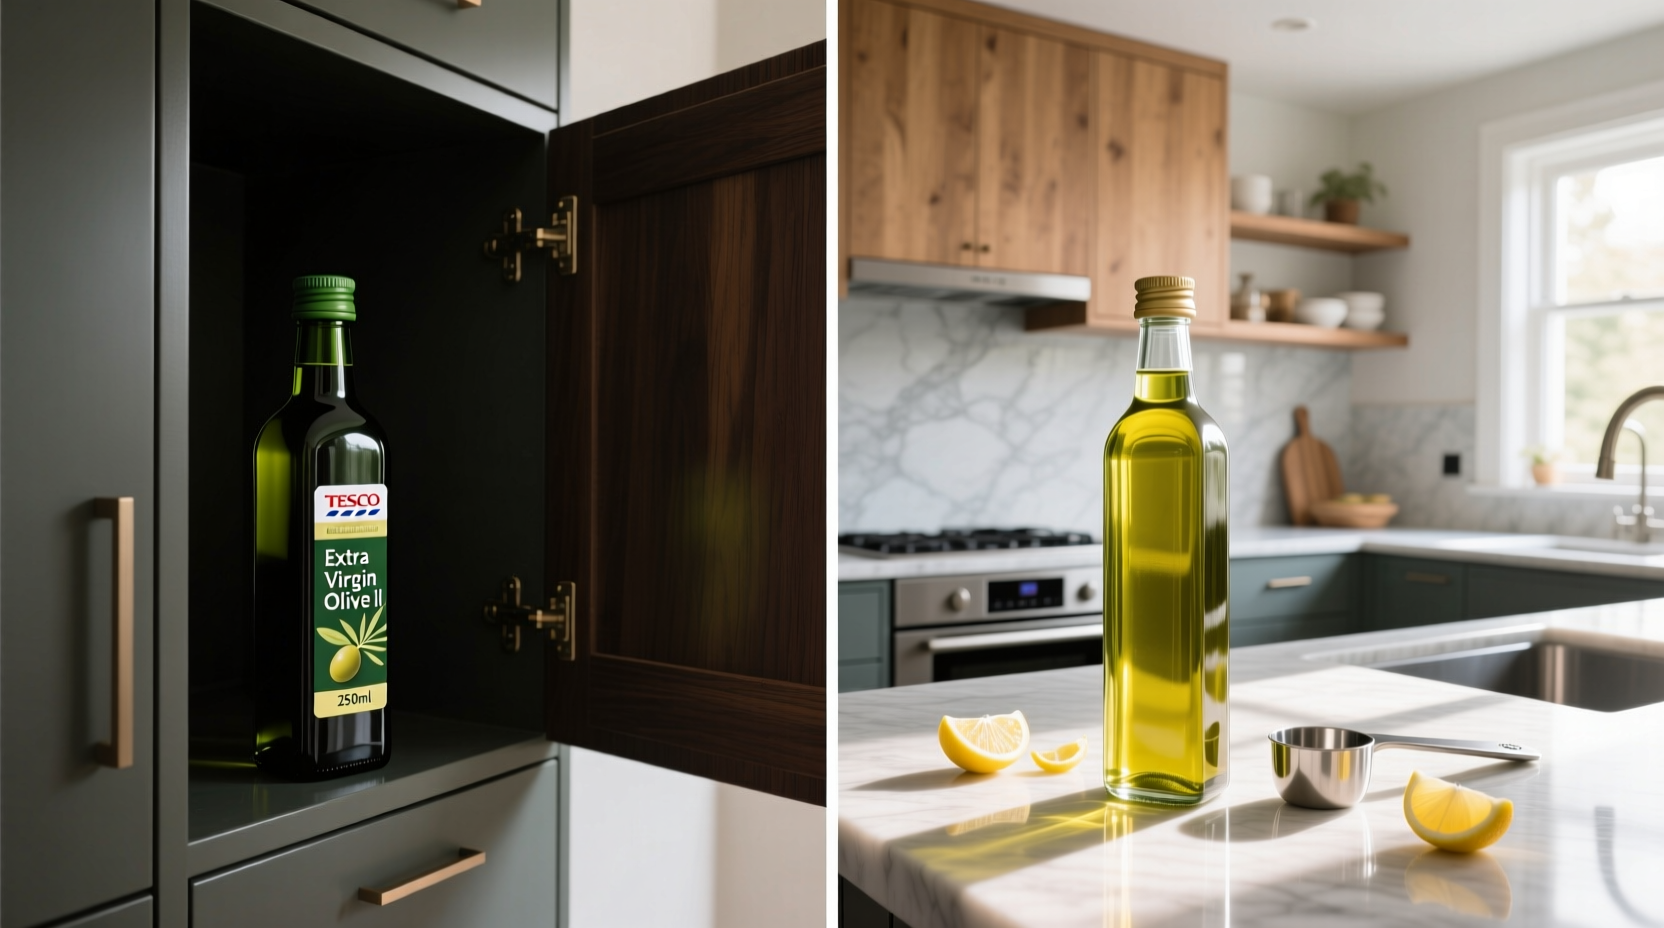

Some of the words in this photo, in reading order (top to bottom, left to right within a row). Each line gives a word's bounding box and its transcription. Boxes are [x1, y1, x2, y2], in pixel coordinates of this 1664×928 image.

[324, 493, 380, 508] TESCO
[325, 549, 369, 567] Extra
[324, 570, 377, 592] Virgin
[324, 591, 370, 611] Olive
[337, 690, 371, 707] 250ml
